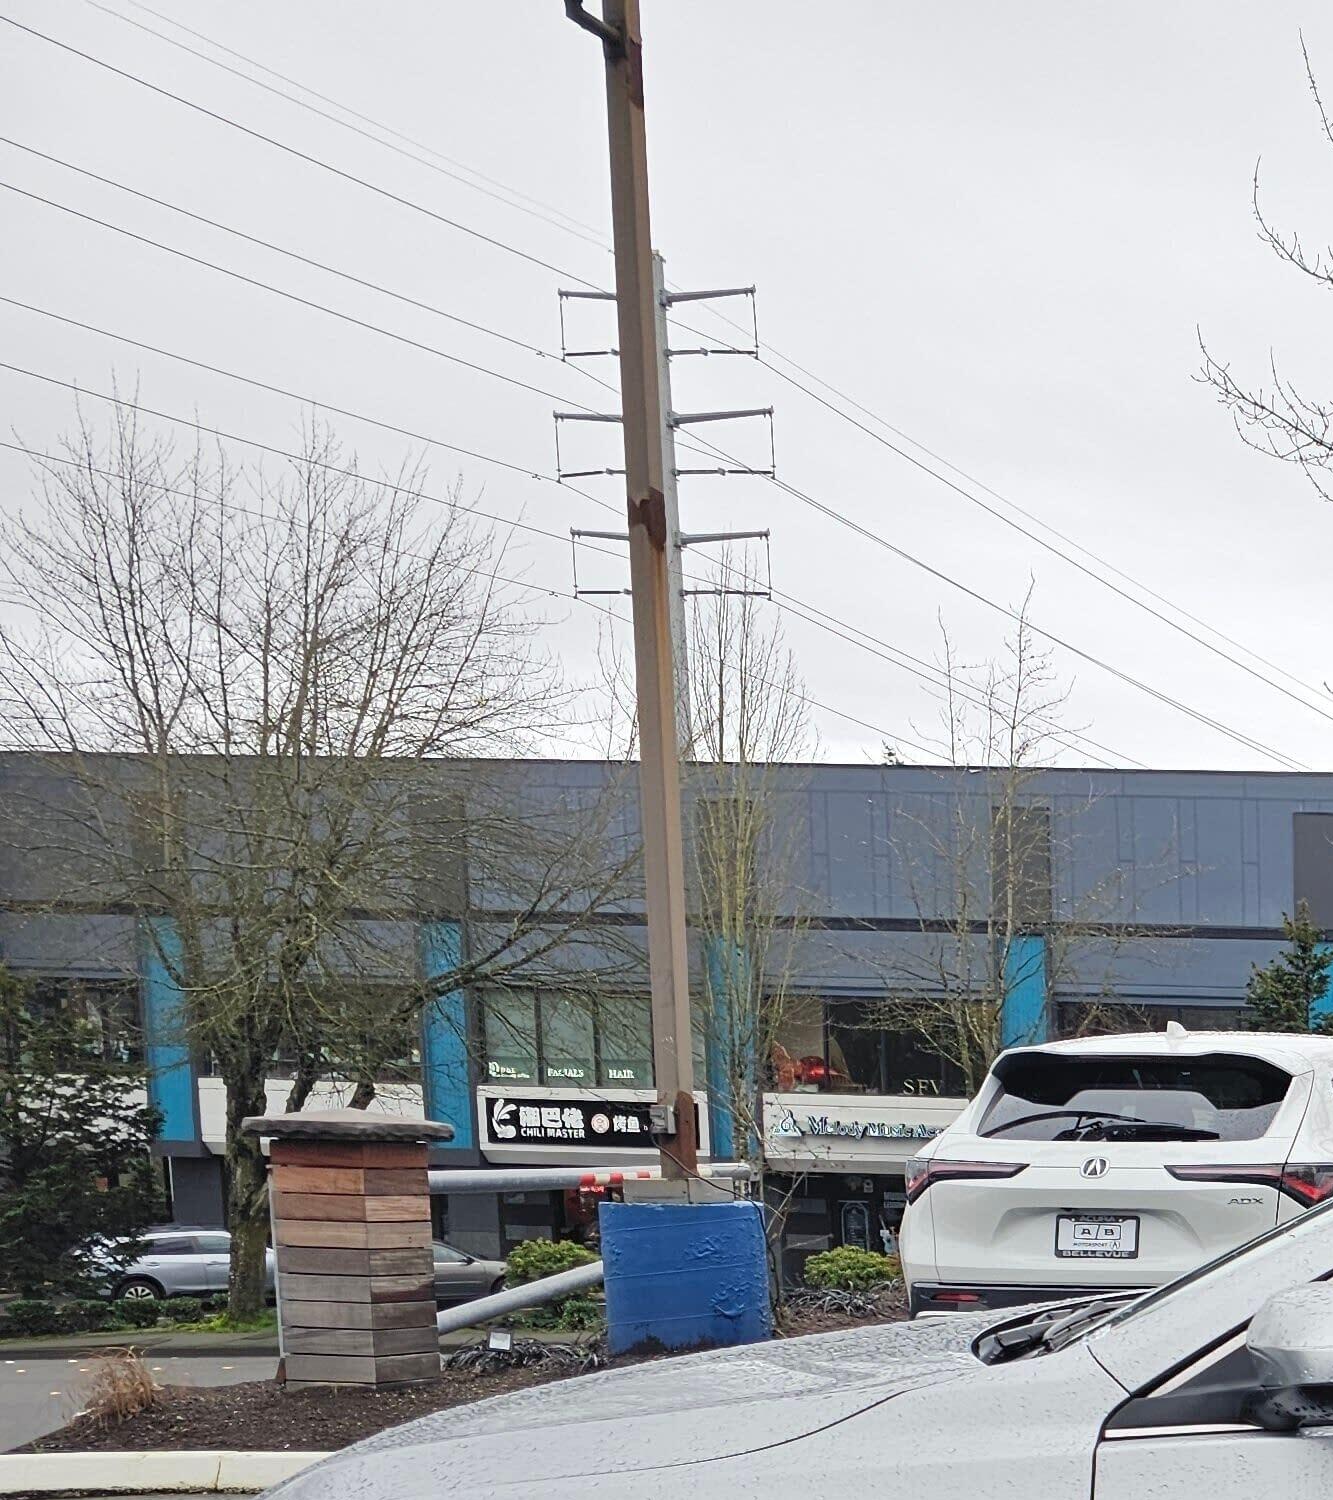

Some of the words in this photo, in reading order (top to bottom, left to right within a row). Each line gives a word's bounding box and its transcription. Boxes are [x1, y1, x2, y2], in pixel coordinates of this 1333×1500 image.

[608, 1069, 635, 1079] HAIR
[520, 1127, 545, 1137] CHILI
[546, 1128, 586, 1139] MASTER
[808, 1116, 866, 1139] Melody
[867, 1121, 912, 1138] Music
[1062, 1250, 1130, 1258] BELLEVUE
